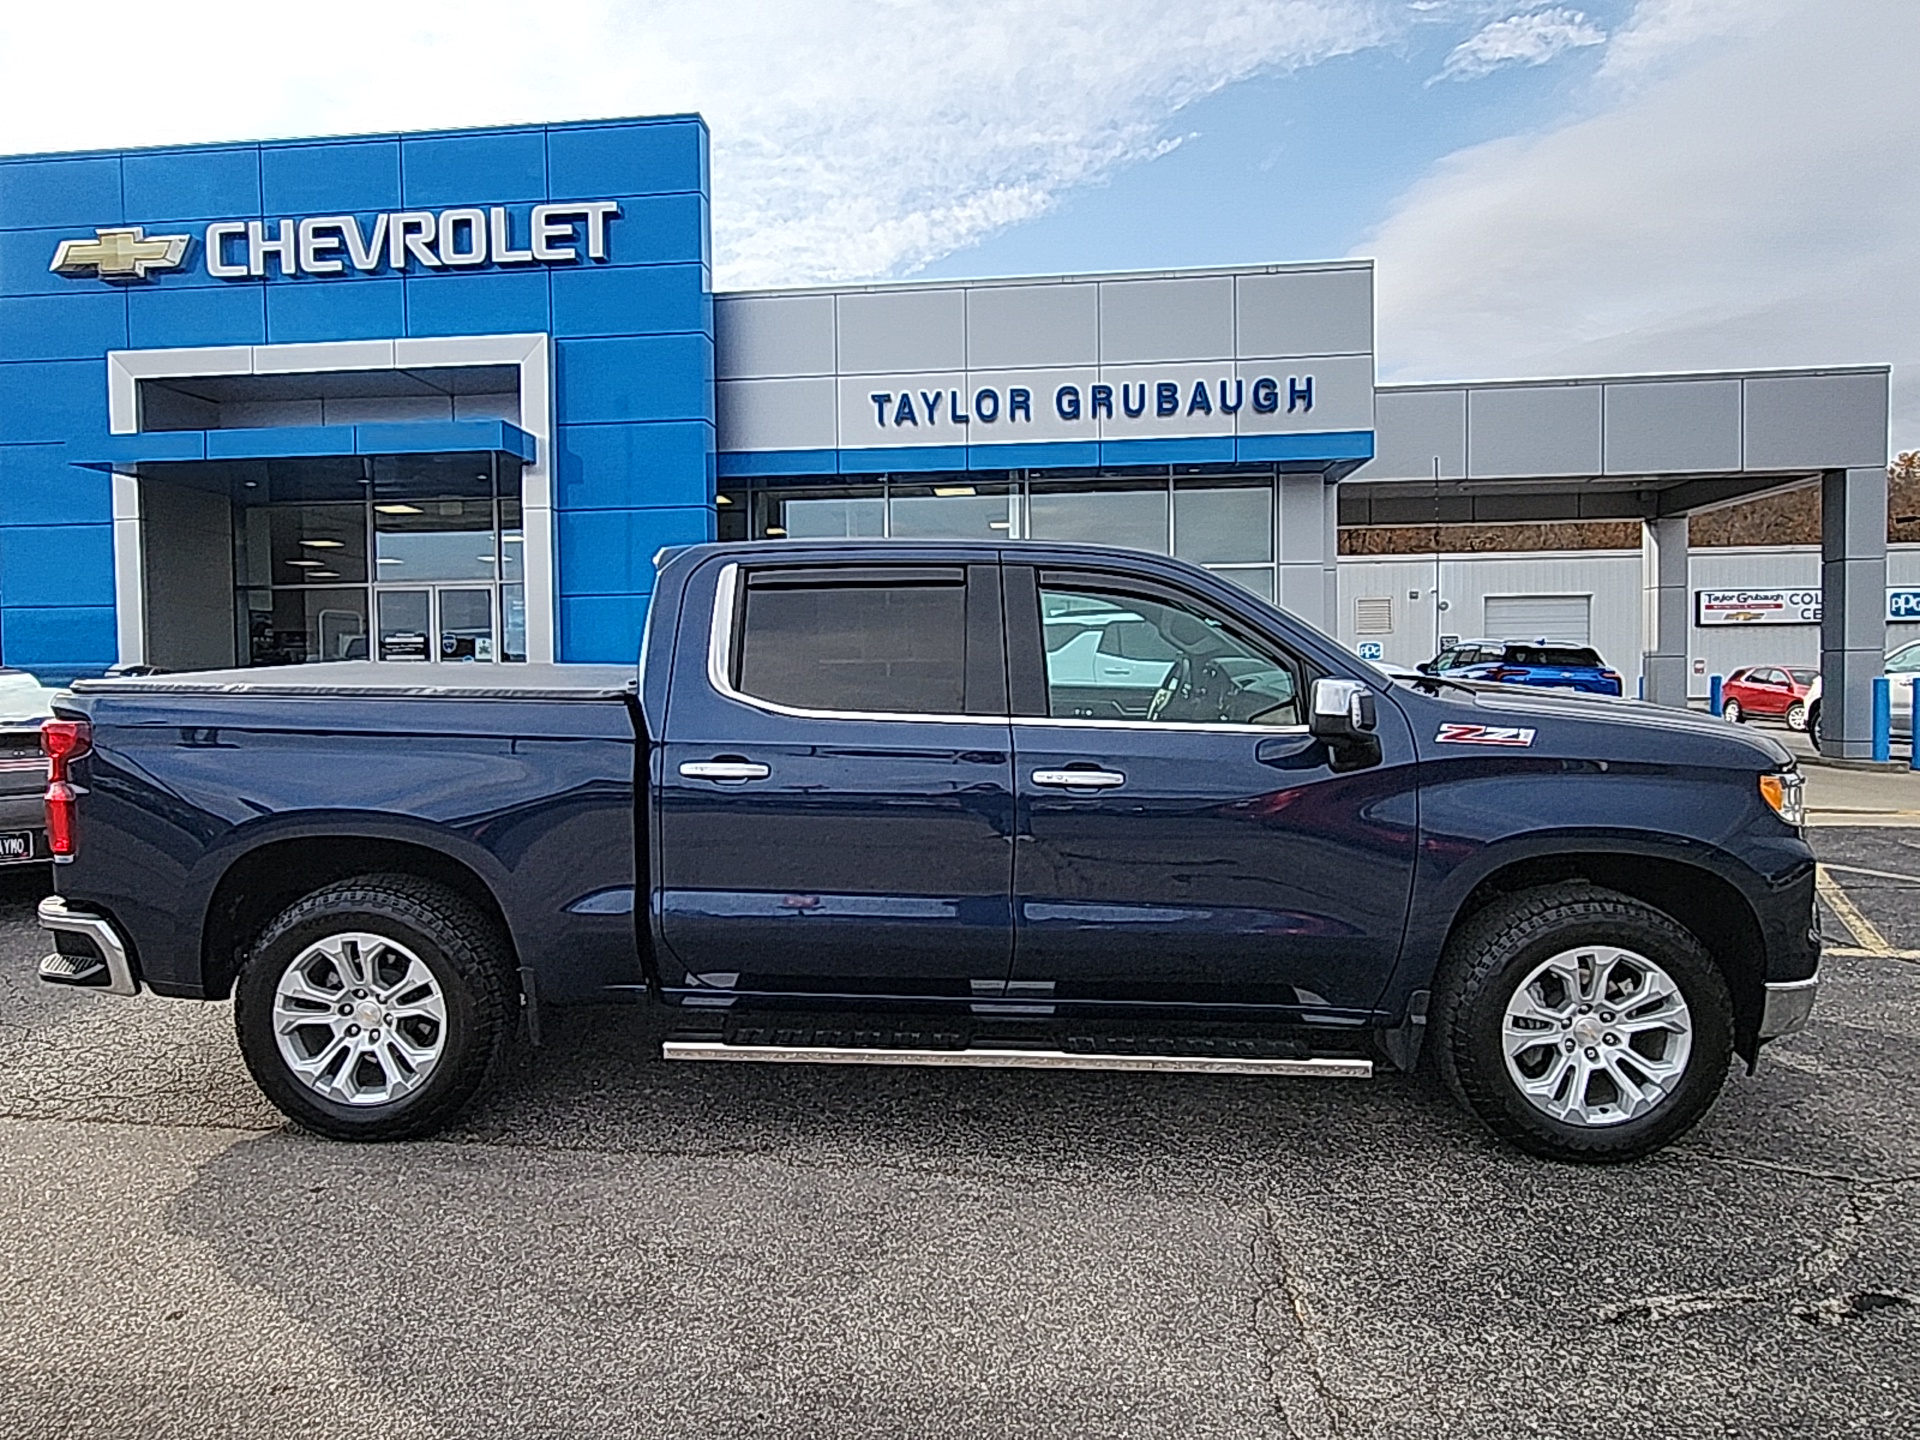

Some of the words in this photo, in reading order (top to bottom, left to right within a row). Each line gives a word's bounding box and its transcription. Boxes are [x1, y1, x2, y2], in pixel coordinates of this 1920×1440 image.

[205, 200, 619, 279] CHEVROLET
[870, 386, 1032, 426] TAYLOR
[1055, 375, 1316, 421] GRUBAUGH
[1704, 593, 1735, 604] Taylor
[1736, 592, 1784, 603] Grubaugh
